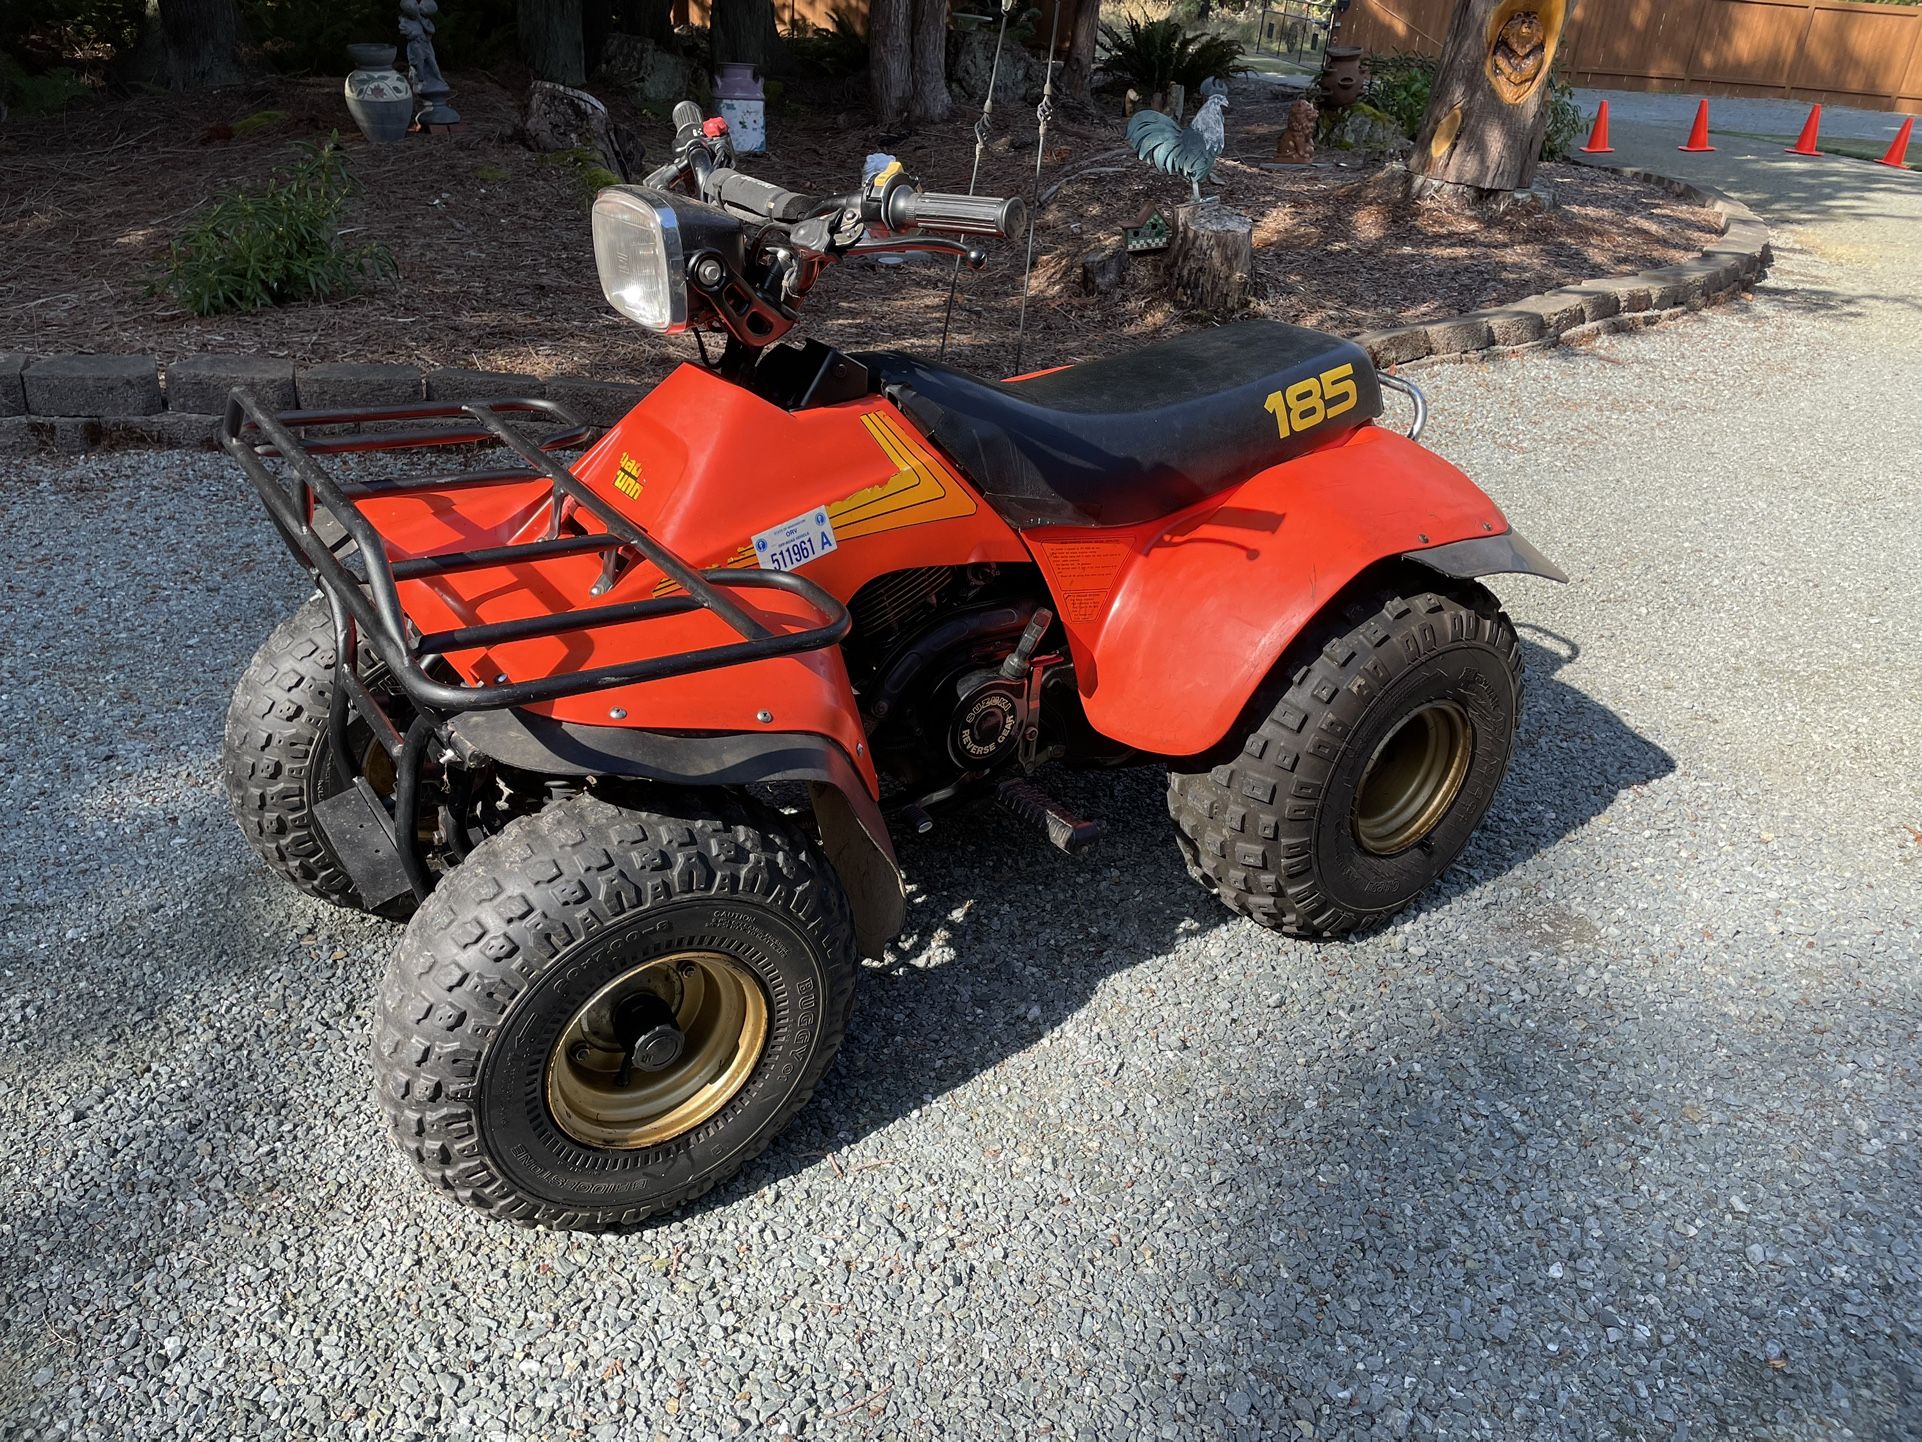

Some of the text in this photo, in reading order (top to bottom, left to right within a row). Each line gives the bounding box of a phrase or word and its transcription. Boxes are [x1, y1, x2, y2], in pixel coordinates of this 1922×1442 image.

[1263, 362, 1358, 439] 185
[770, 531, 832, 571] 511961 A
[786, 528, 798, 538] ORV
[965, 696, 1011, 723] SUZUKI
[961, 714, 1015, 755] REVERSE GEAR
[713, 910, 756, 923] CAUTION
[788, 977, 815, 1062] BUGGY
